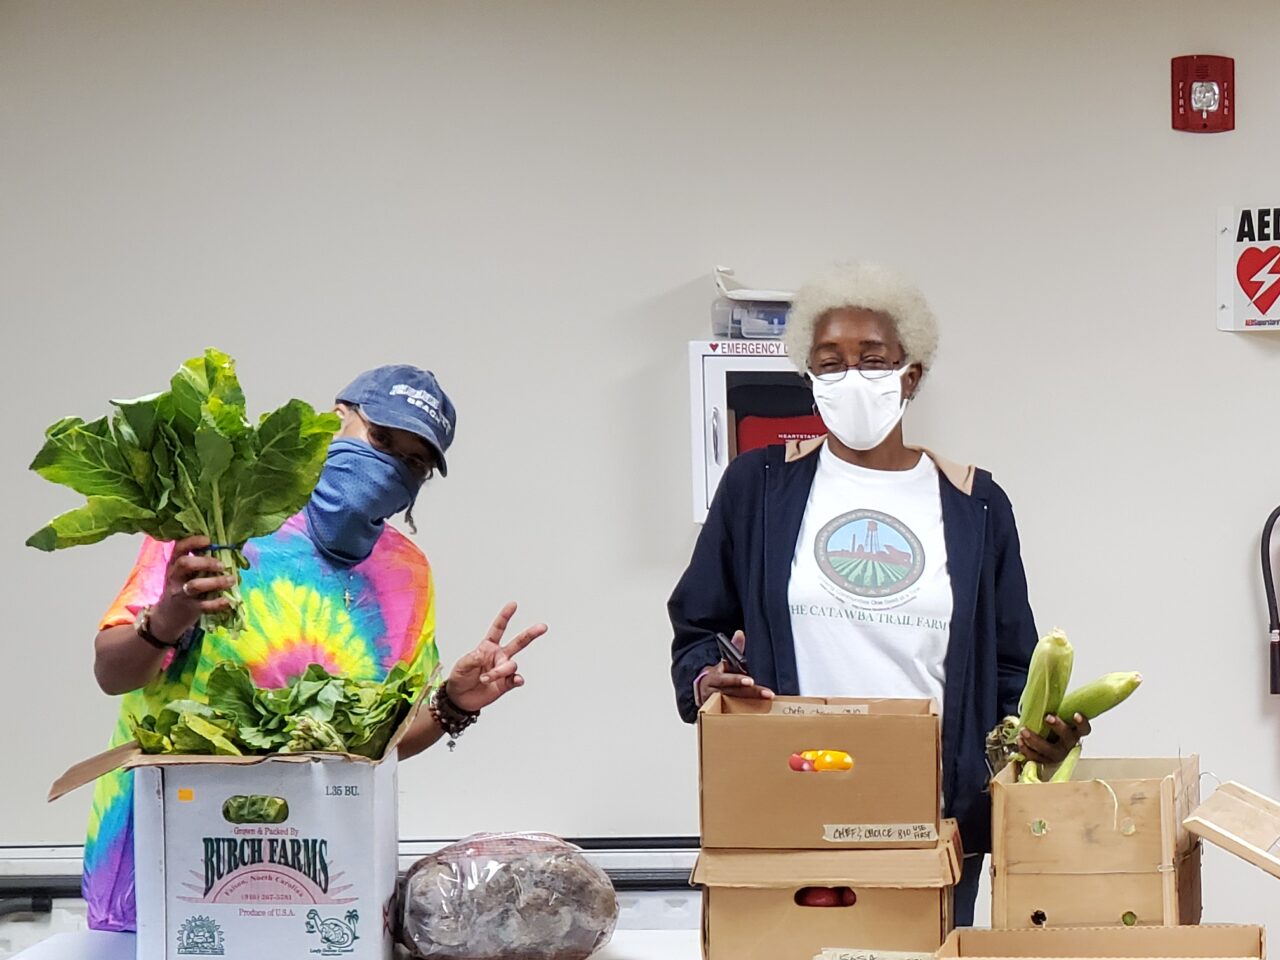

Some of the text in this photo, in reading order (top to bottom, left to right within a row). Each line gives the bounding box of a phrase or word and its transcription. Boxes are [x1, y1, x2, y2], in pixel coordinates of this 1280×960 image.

[721, 343, 781, 354] EMERGENCY
[809, 606, 874, 622] CATAWBA
[877, 613, 914, 626] TRAIL
[325, 786, 342, 796] 1.35
[234, 827, 299, 837] Grown & Packed By
[864, 827, 893, 838] CHOICE
[914, 831, 932, 839] FIRST
[202, 837, 329, 899] BURCH FARMS
[250, 874, 273, 882] North
[275, 876, 304, 898] Carolina
[239, 908, 296, 917] Produce of U.S.A.
